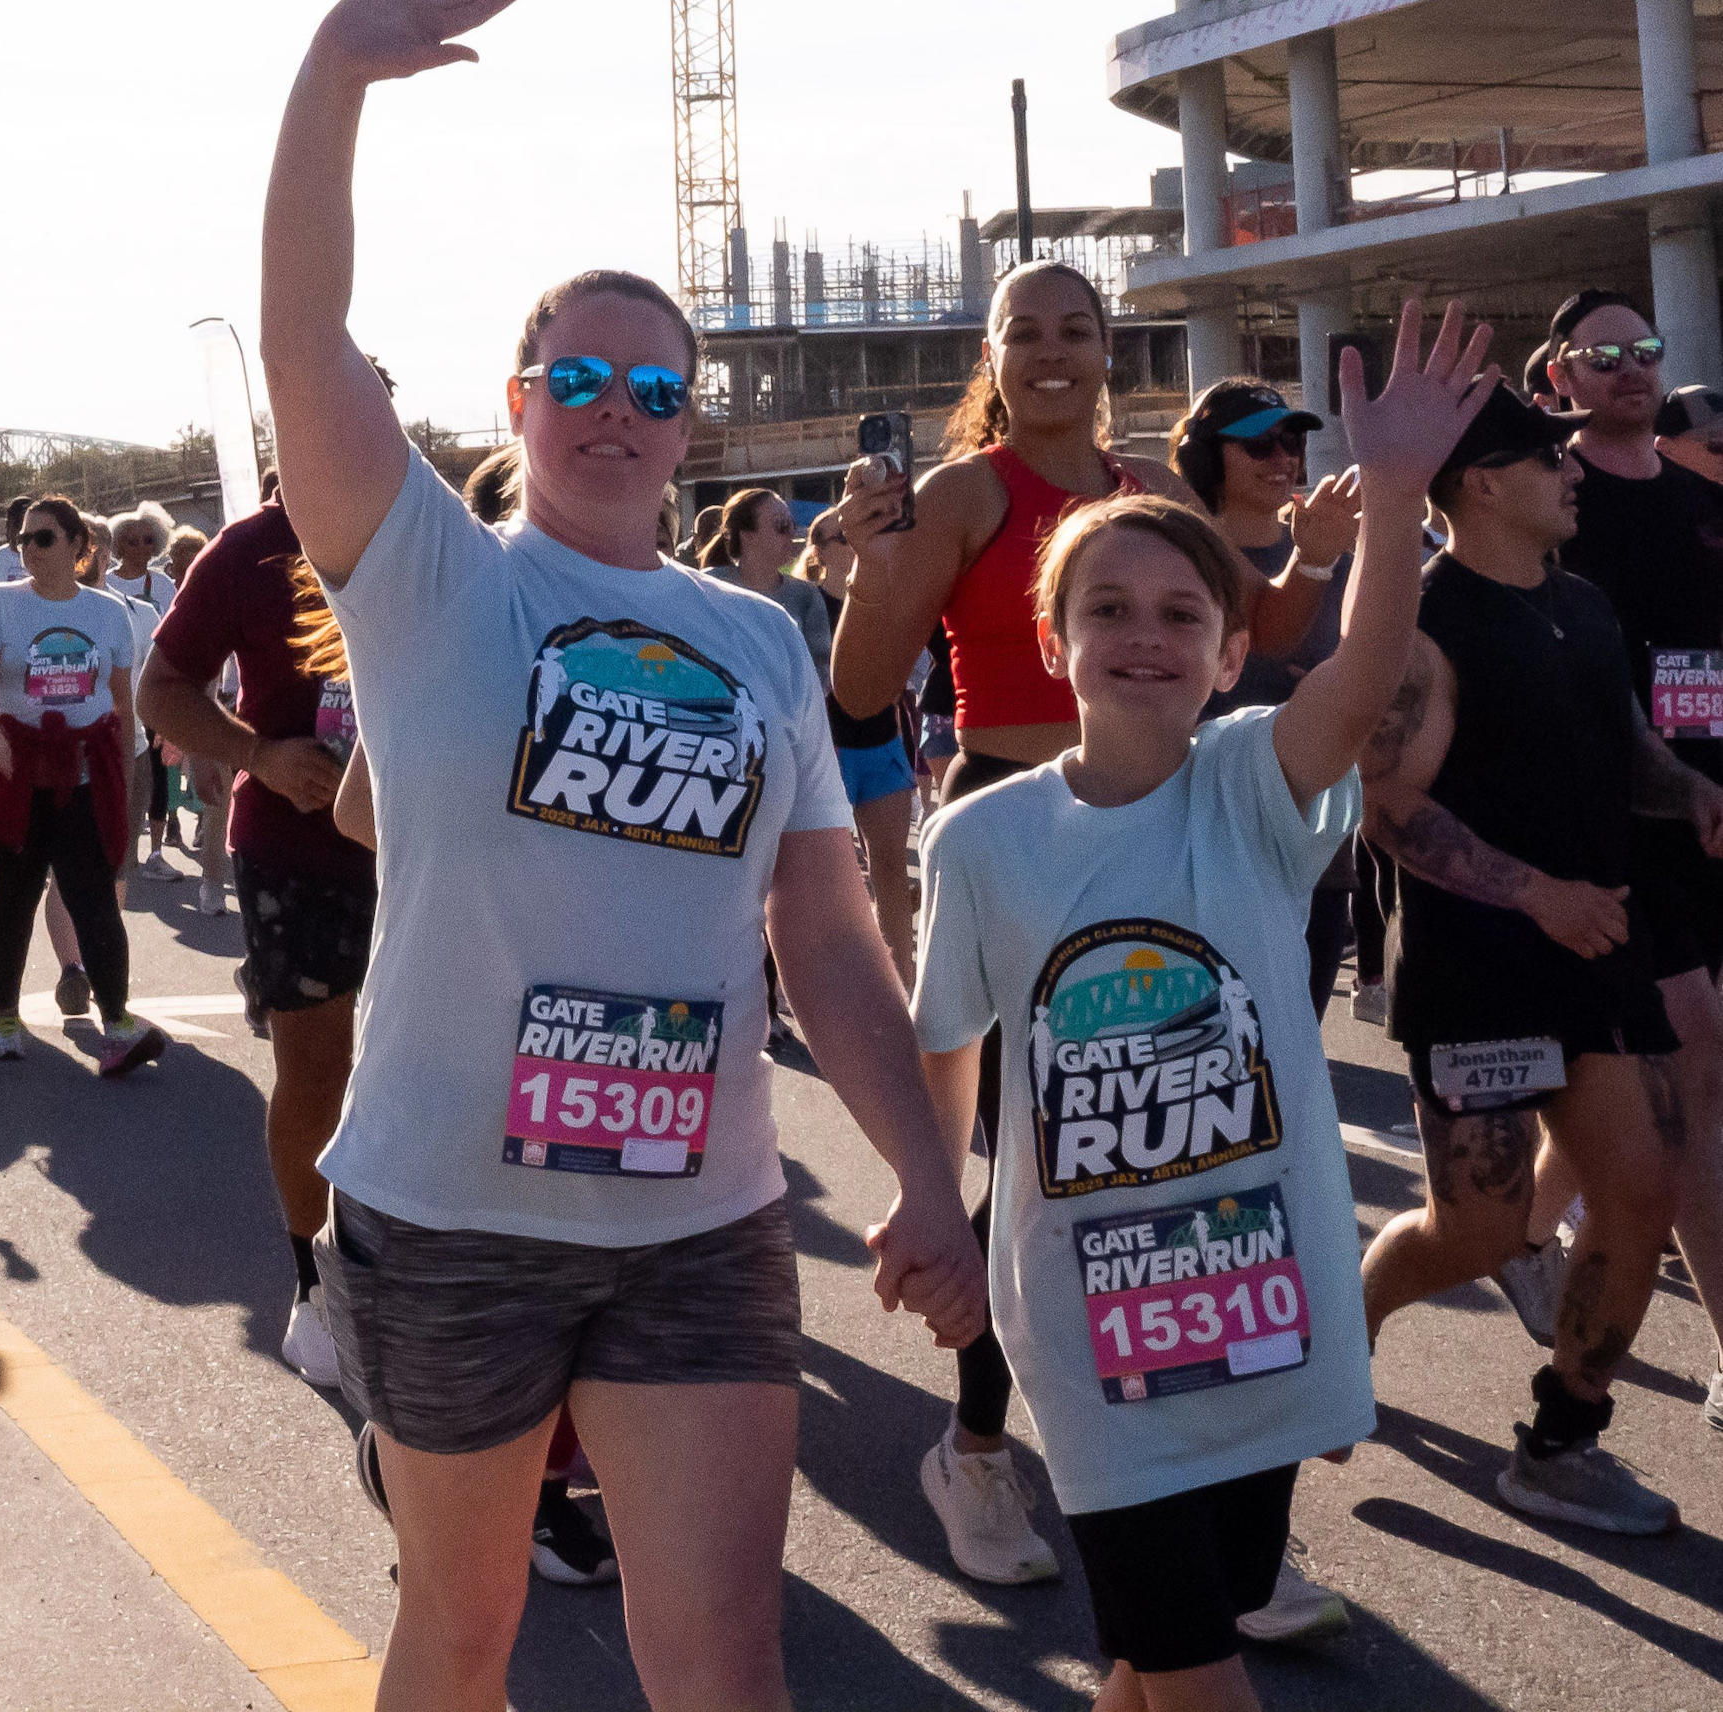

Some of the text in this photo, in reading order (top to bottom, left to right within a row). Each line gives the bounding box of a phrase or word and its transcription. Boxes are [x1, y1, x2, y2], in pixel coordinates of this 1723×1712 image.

[1654, 668, 1705, 686] RIVER
[1656, 654, 1691, 668] GATE
[320, 692, 353, 709] RIV
[569, 681, 667, 726] GATE
[1658, 692, 1723, 718] 1558
[560, 710, 737, 778] RIVER
[528, 749, 748, 839] RUN
[539, 807, 722, 852] 2025 JAX 48TH ANNUAL
[1094, 924, 1147, 939] CLASSIC
[529, 994, 605, 1028] GATE
[518, 1022, 710, 1074] RIVER RUN
[1056, 1033, 1157, 1074] GATE
[1447, 1048, 1545, 1069] Jonathan
[1061, 1048, 1230, 1119] RIVER
[1465, 1066, 1531, 1088] 4797
[520, 1072, 705, 1137] 15309
[1054, 1081, 1256, 1181] RUN
[1109, 1172, 1139, 1185] JAX
[1152, 1161, 1193, 1180] 48TH
[1197, 1142, 1258, 1170] ANNUAL
[1082, 1223, 1157, 1257] GATE
[1086, 1229, 1283, 1295] RIVER RUN
[1099, 1274, 1299, 1357] 15310
